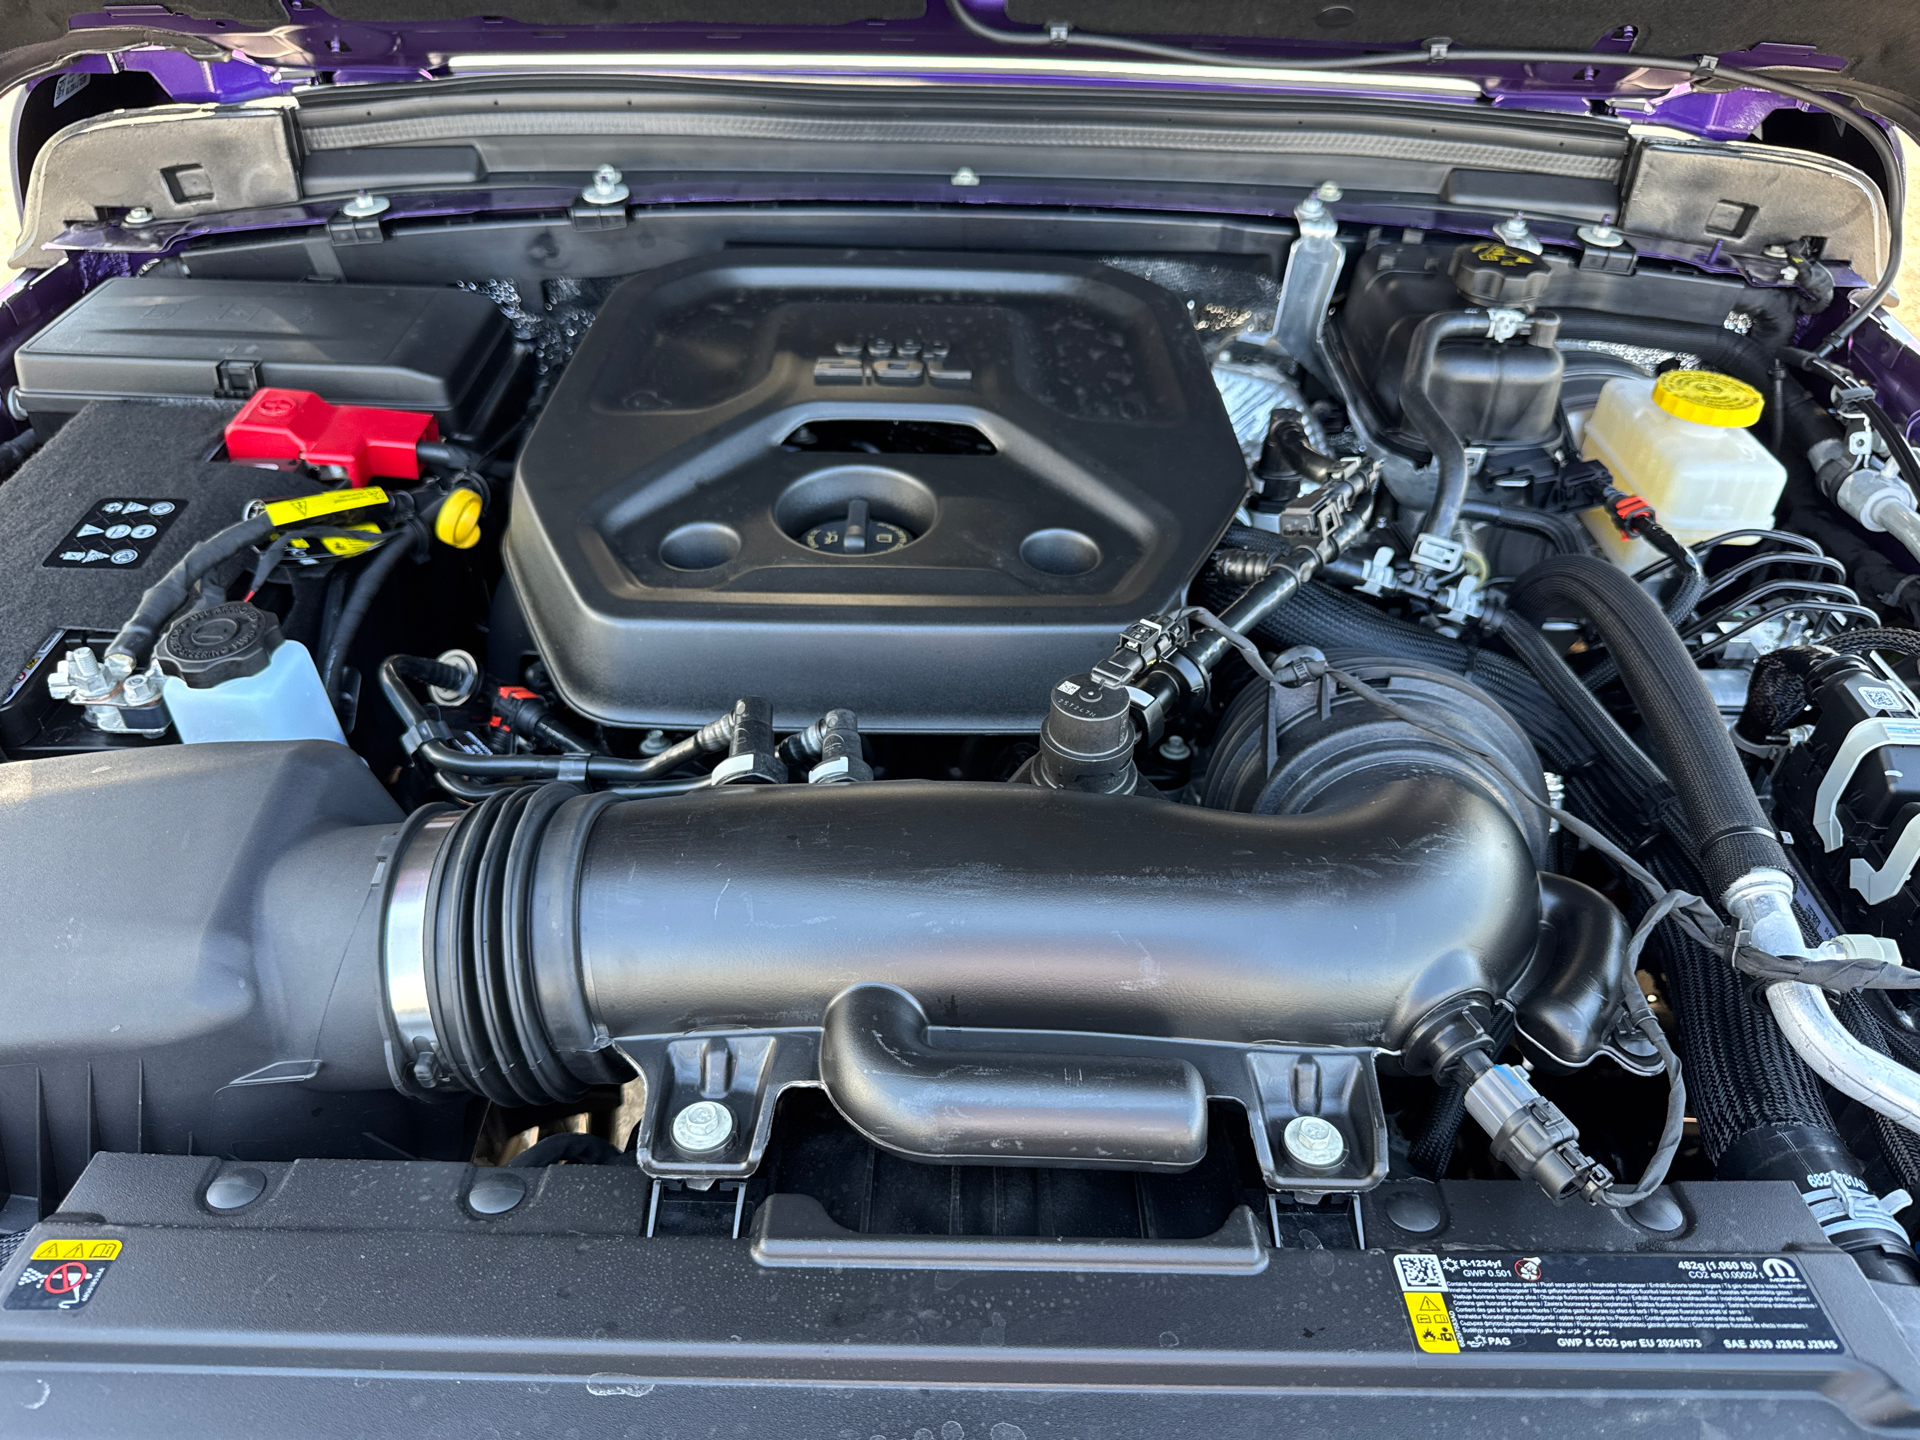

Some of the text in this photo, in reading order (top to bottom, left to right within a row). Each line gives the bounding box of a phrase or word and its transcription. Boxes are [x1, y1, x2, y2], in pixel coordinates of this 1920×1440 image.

[813, 357, 973, 387] 2.0L
[1459, 1259, 1502, 1269] R-1234yf
[1678, 1260, 1705, 1272] 482g
[1740, 1261, 1757, 1272] lb)
[1463, 1269, 1512, 1277] GWP 0.501
[1688, 1271, 1710, 1279] CO2
[1711, 1272, 1722, 1280] eq
[1487, 1337, 1512, 1346] PAG
[1556, 1338, 1702, 1350] GWP & CO2 per EU 2024/573
[1723, 1338, 1748, 1349] SAE
